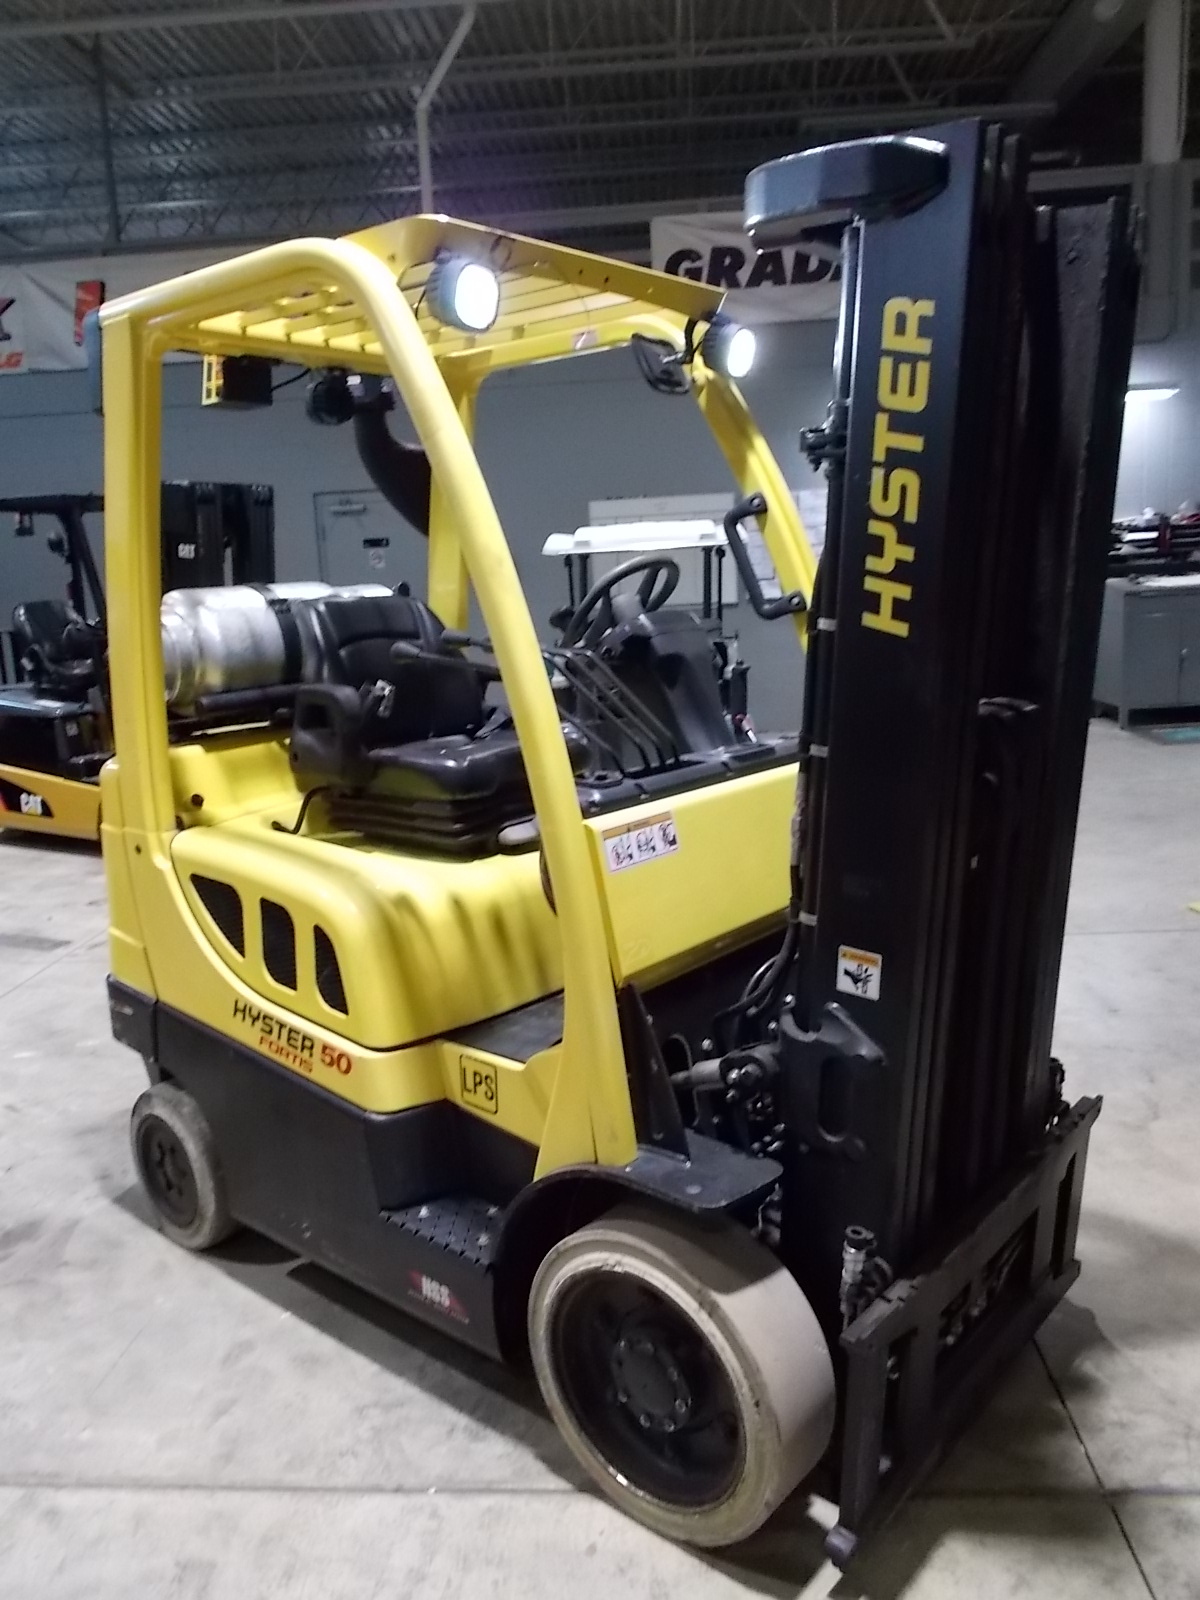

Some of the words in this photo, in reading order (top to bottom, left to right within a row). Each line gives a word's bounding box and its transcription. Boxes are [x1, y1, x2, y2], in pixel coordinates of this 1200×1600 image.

[861, 296, 936, 638] HYSTER
[233, 999, 315, 1058] HYSTER
[321, 1042, 352, 1075] 50
[462, 1065, 494, 1101] LPS
